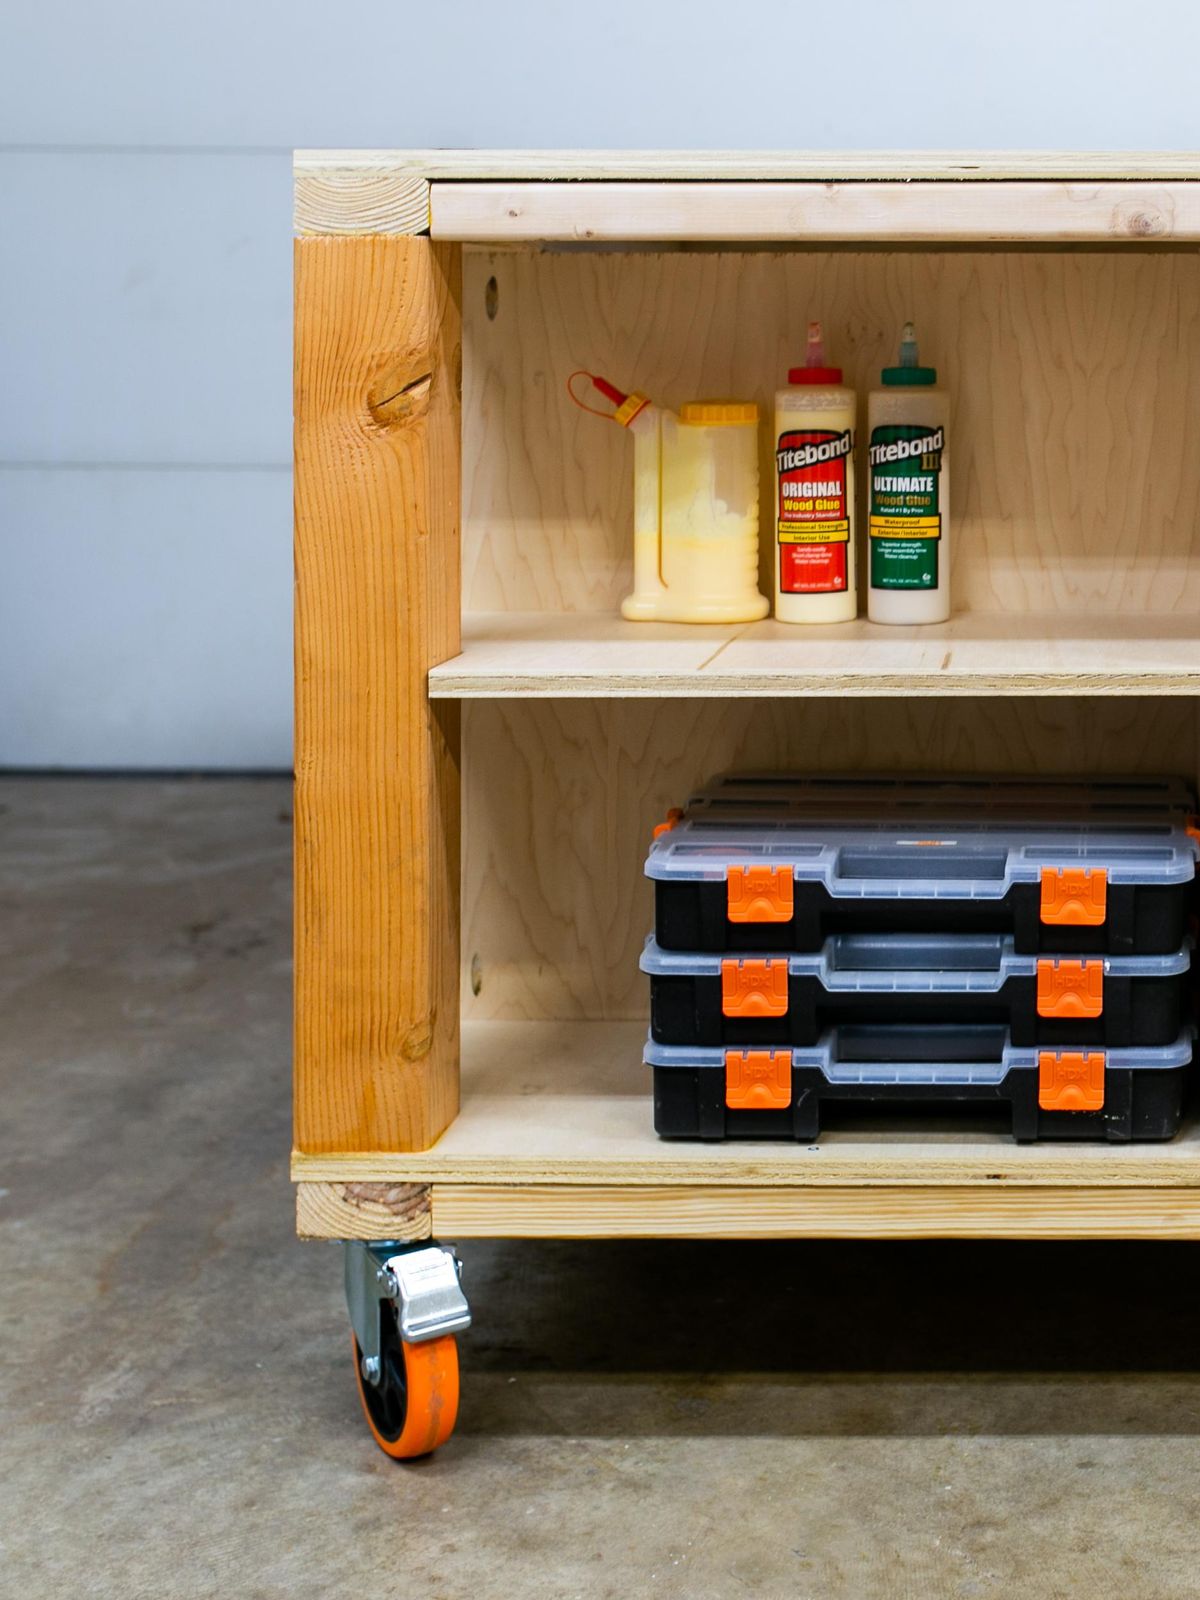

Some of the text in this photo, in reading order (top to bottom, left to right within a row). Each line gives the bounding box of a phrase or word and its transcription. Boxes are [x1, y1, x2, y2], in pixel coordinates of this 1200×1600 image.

[777, 433, 849, 472] Titebond
[870, 430, 942, 466] Titebond
[922, 453, 939, 470] III
[782, 481, 842, 497] ORIGINAL
[874, 476, 934, 492] ULTIMATE
[784, 499, 840, 511] Wood Glue
[876, 495, 931, 506] Wood Glue
[818, 522, 844, 530] Strength
[884, 518, 920, 526] Waterproof
